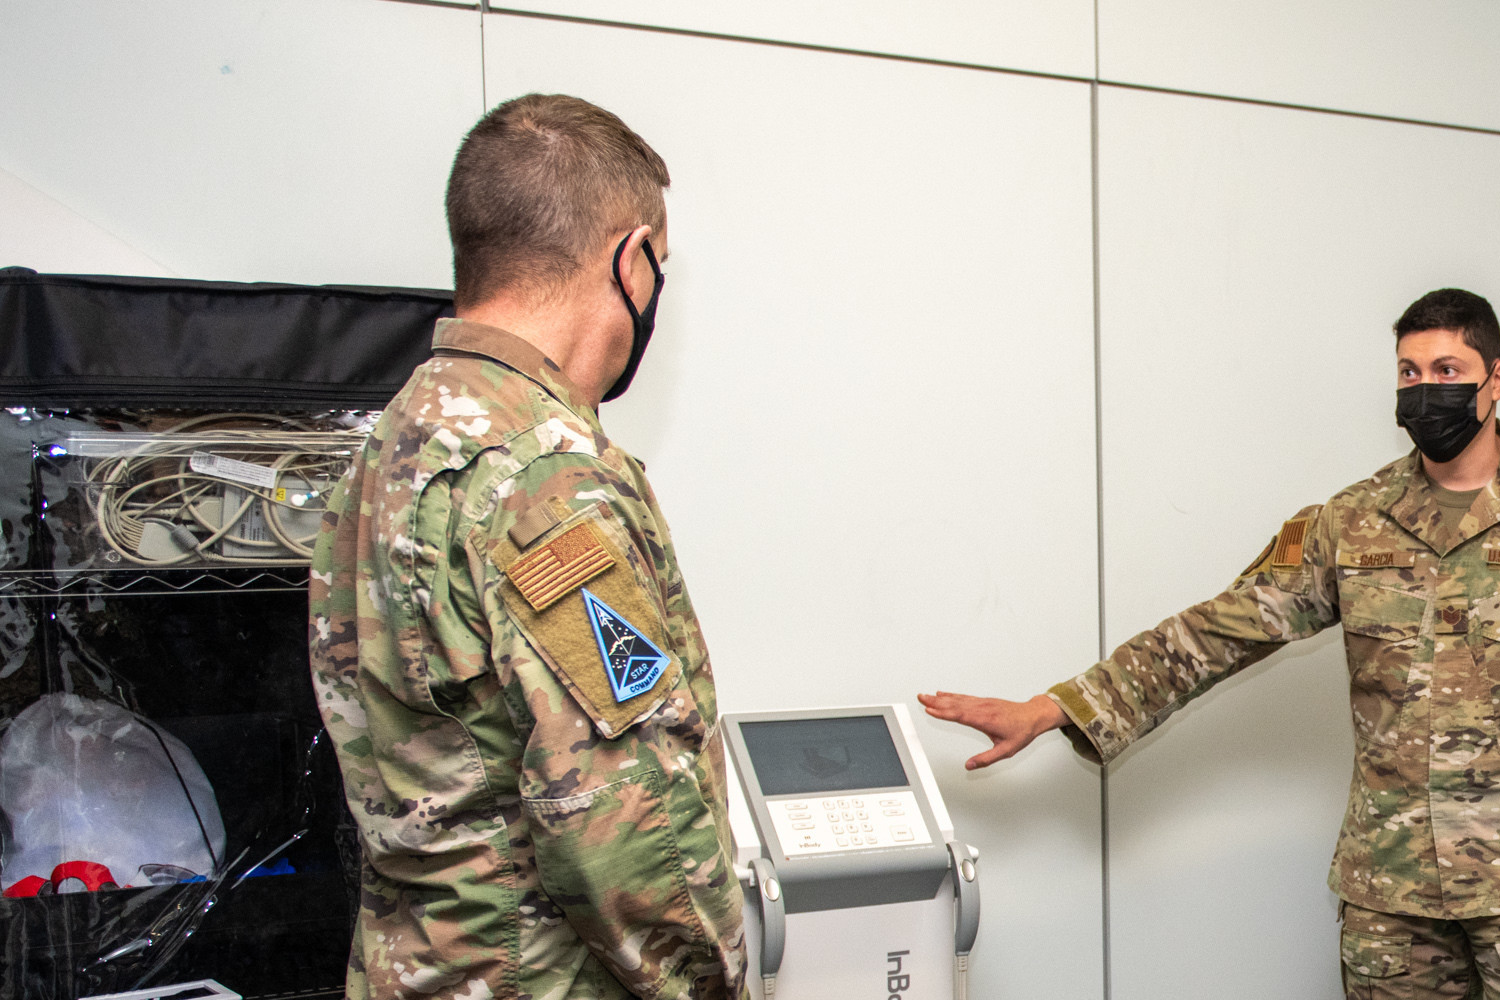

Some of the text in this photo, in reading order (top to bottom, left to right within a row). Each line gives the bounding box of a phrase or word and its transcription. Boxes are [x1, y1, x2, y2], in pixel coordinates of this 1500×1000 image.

[1360, 553, 1394, 566] GARCIA
[630, 663, 649, 680] STAR
[630, 667, 659, 693] COMMAND
